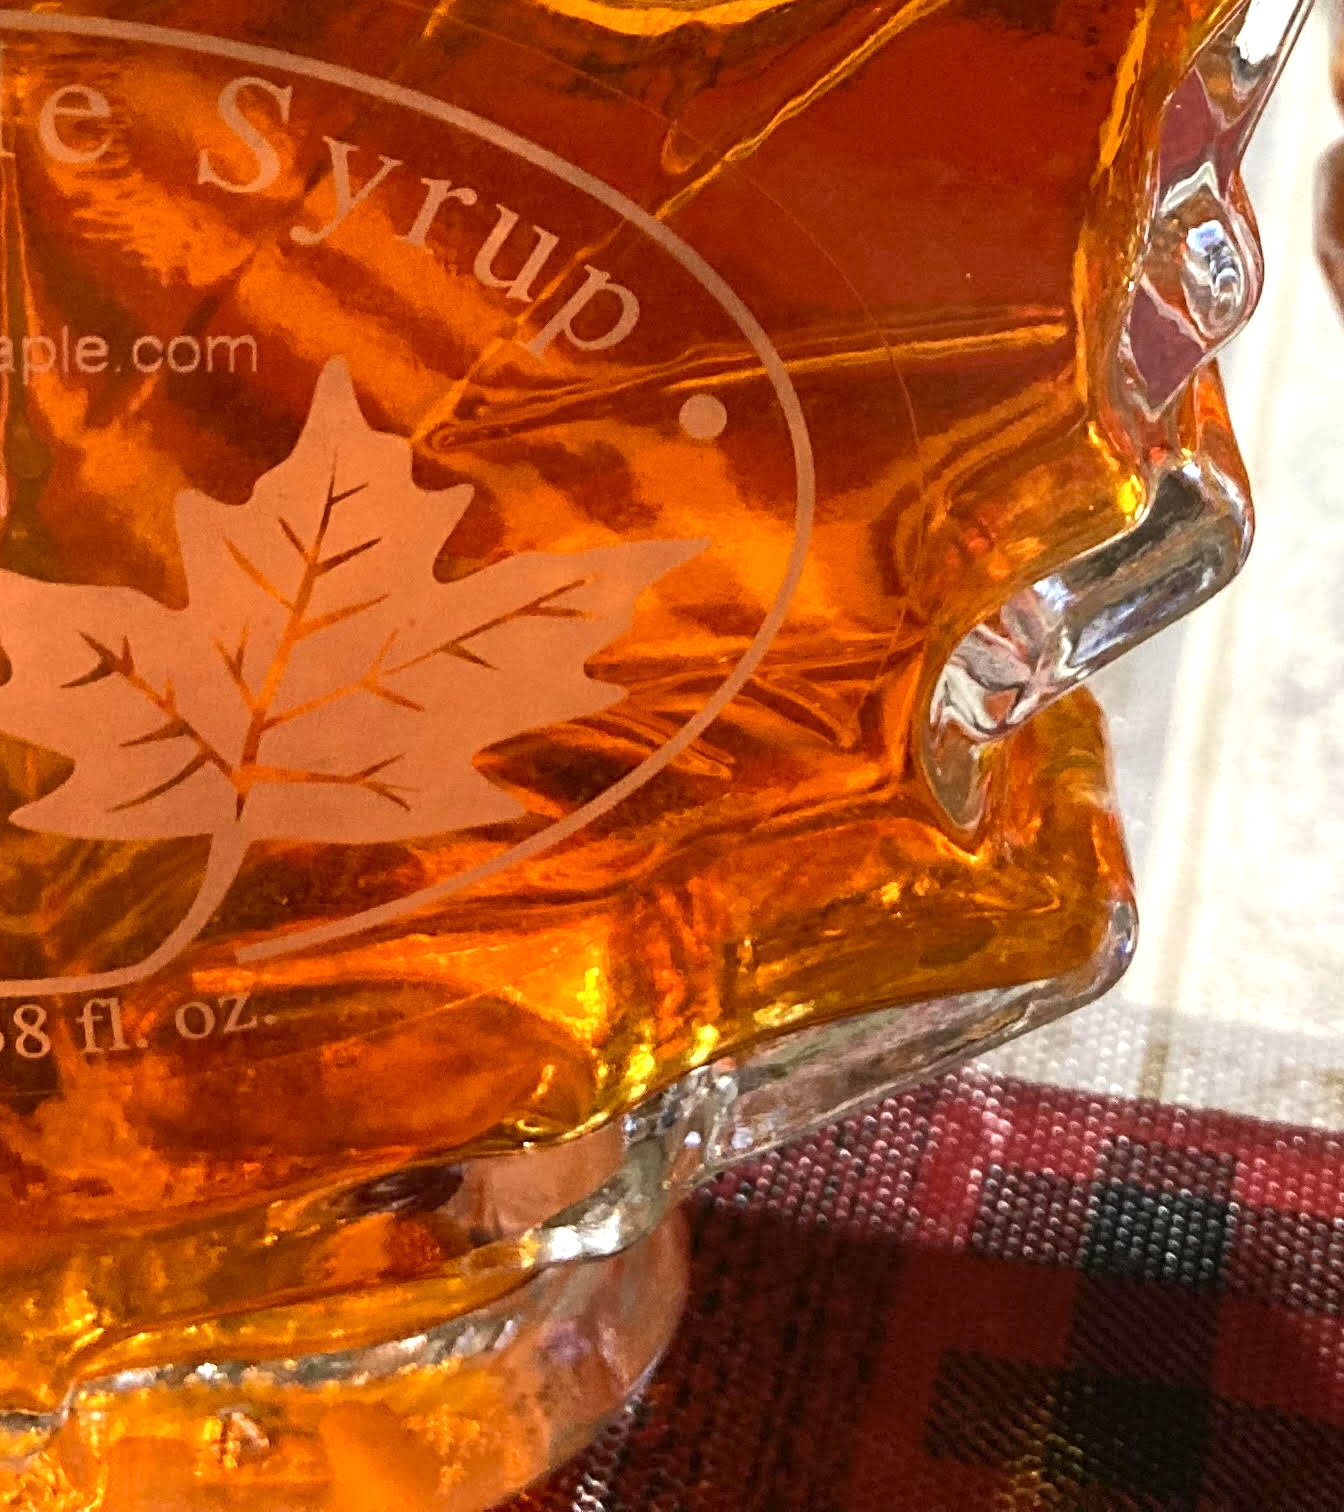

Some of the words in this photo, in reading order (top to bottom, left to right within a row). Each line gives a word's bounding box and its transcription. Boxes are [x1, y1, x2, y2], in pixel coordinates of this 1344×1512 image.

[198, 76, 640, 357] Syrup
[77, 990, 150, 1055] fl.
[173, 990, 276, 1041] oz.
